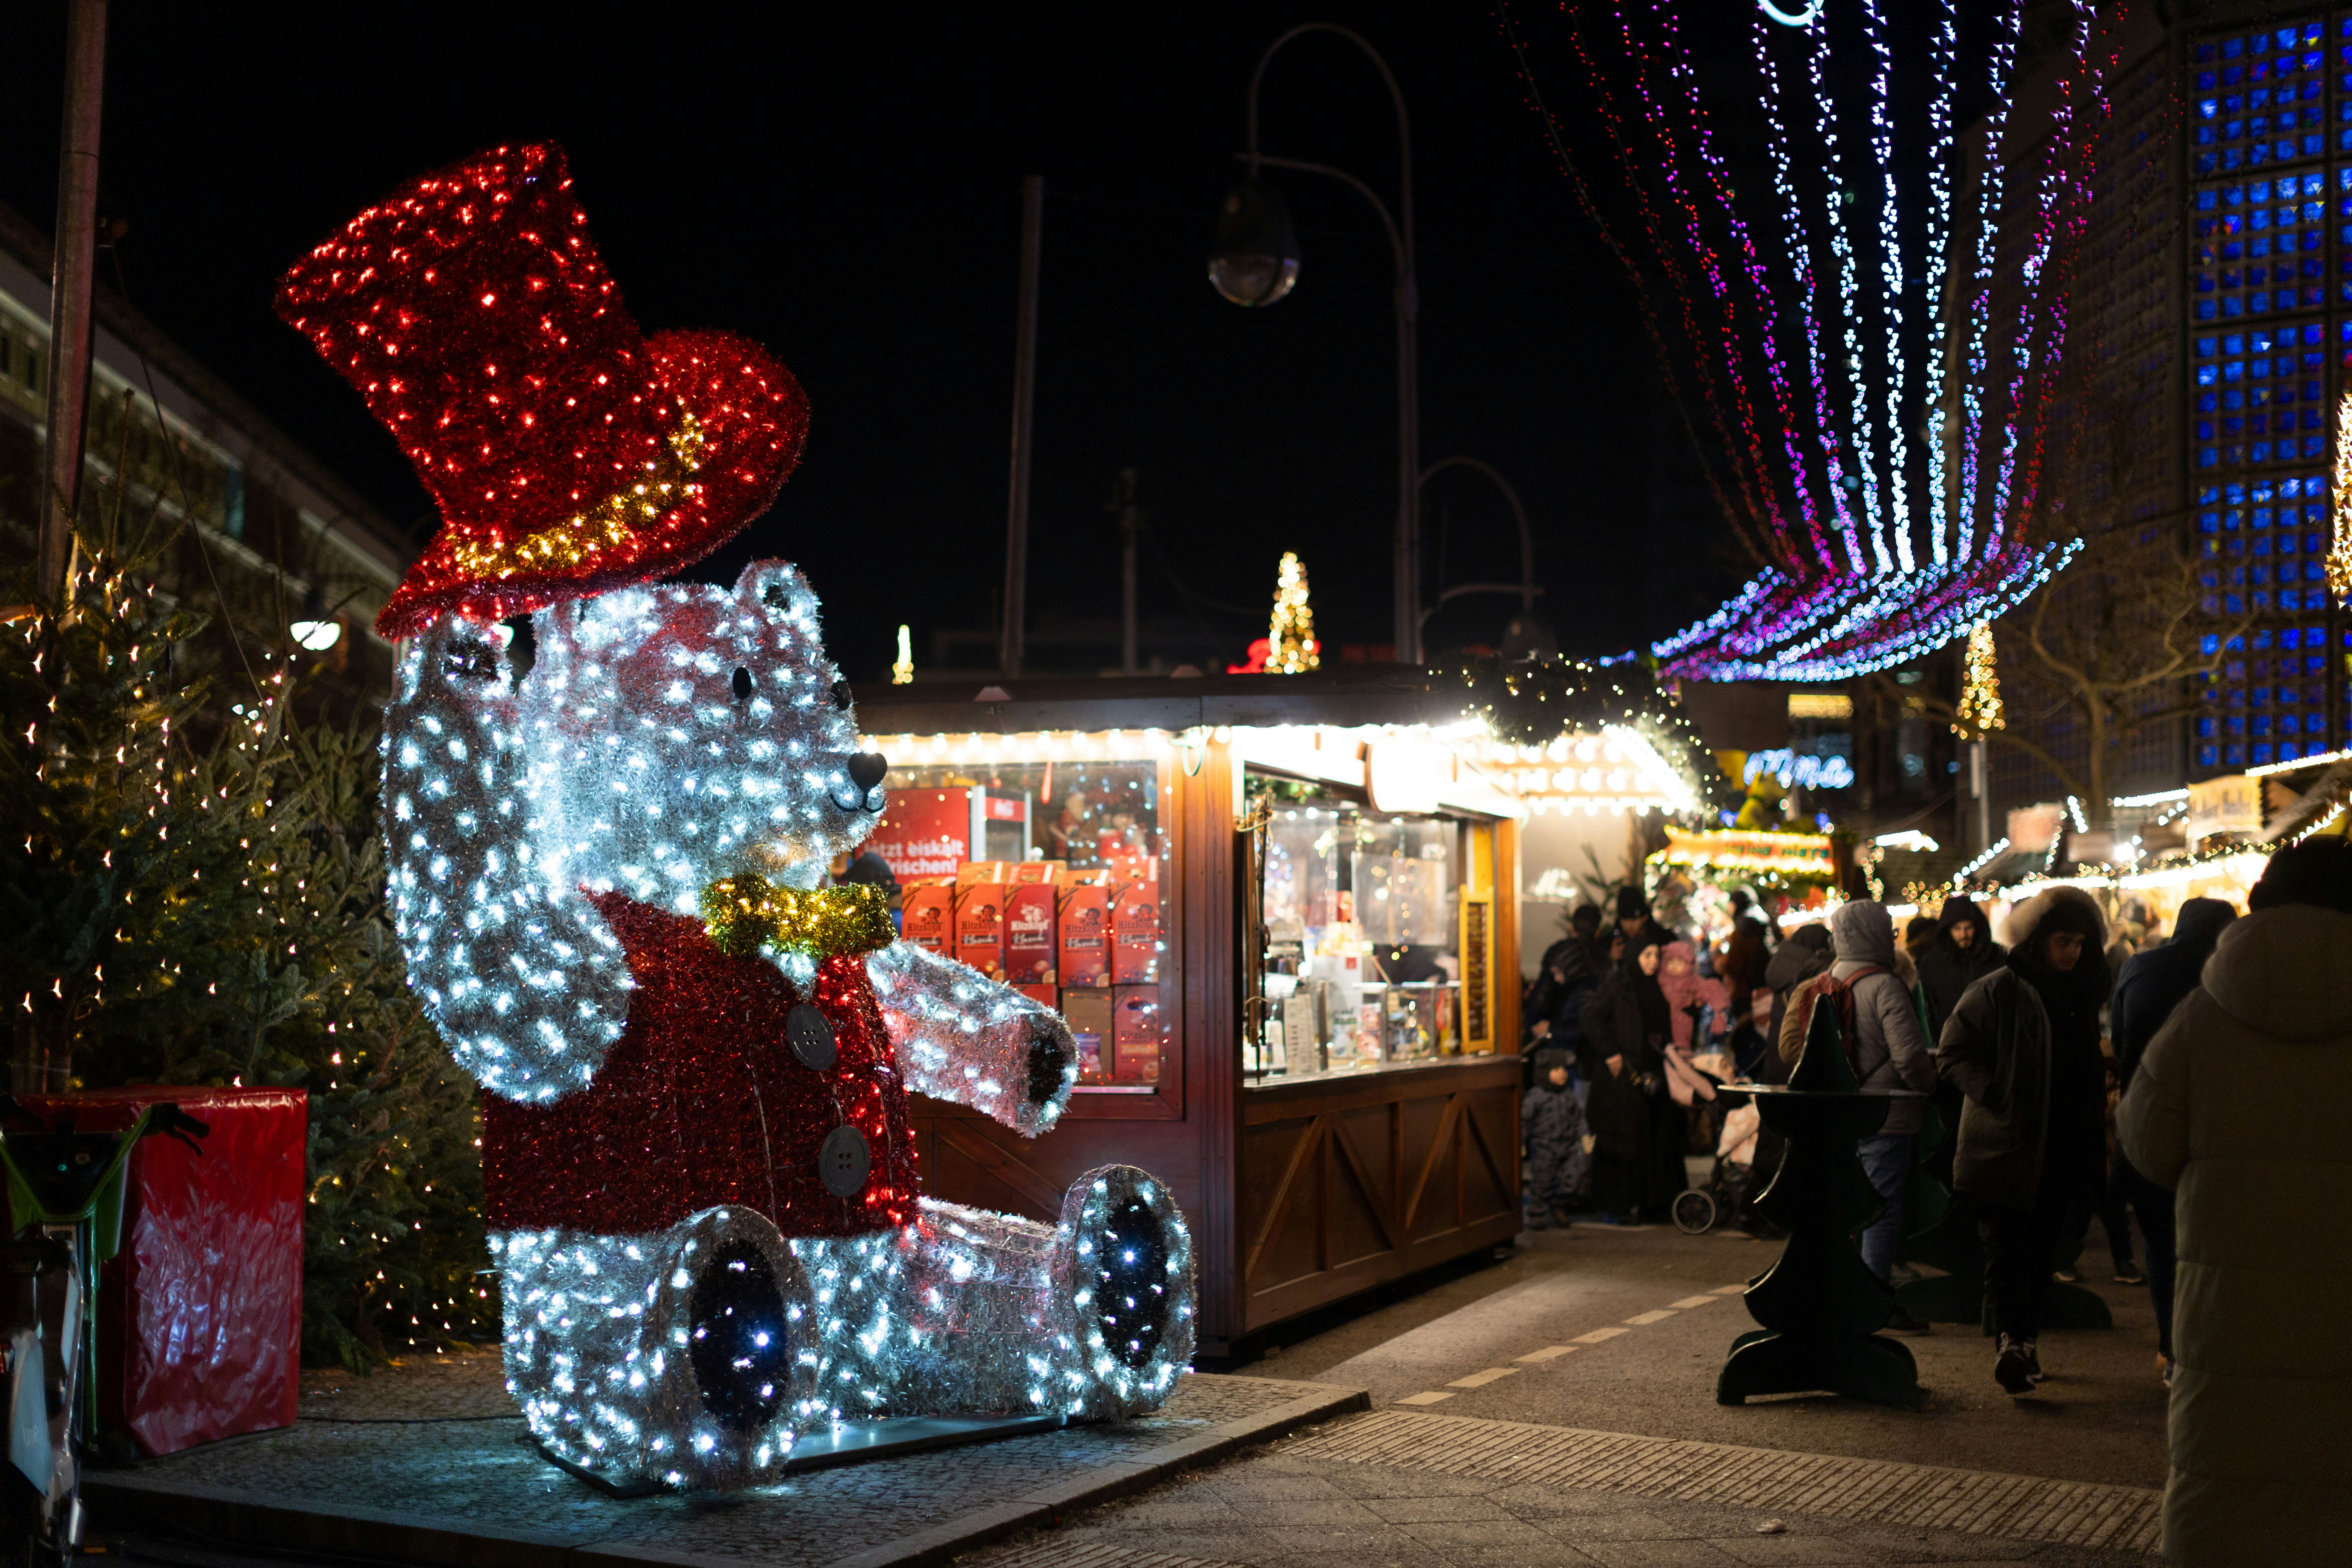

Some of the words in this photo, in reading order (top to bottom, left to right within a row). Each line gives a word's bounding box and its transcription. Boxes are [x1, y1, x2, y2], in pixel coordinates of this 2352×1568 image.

[907, 839, 964, 857] eiskalt
[907, 922, 944, 933] Hitzkopf
[961, 920, 997, 931] Hitzkopf
[1064, 923, 1104, 935] Hitzkopf
